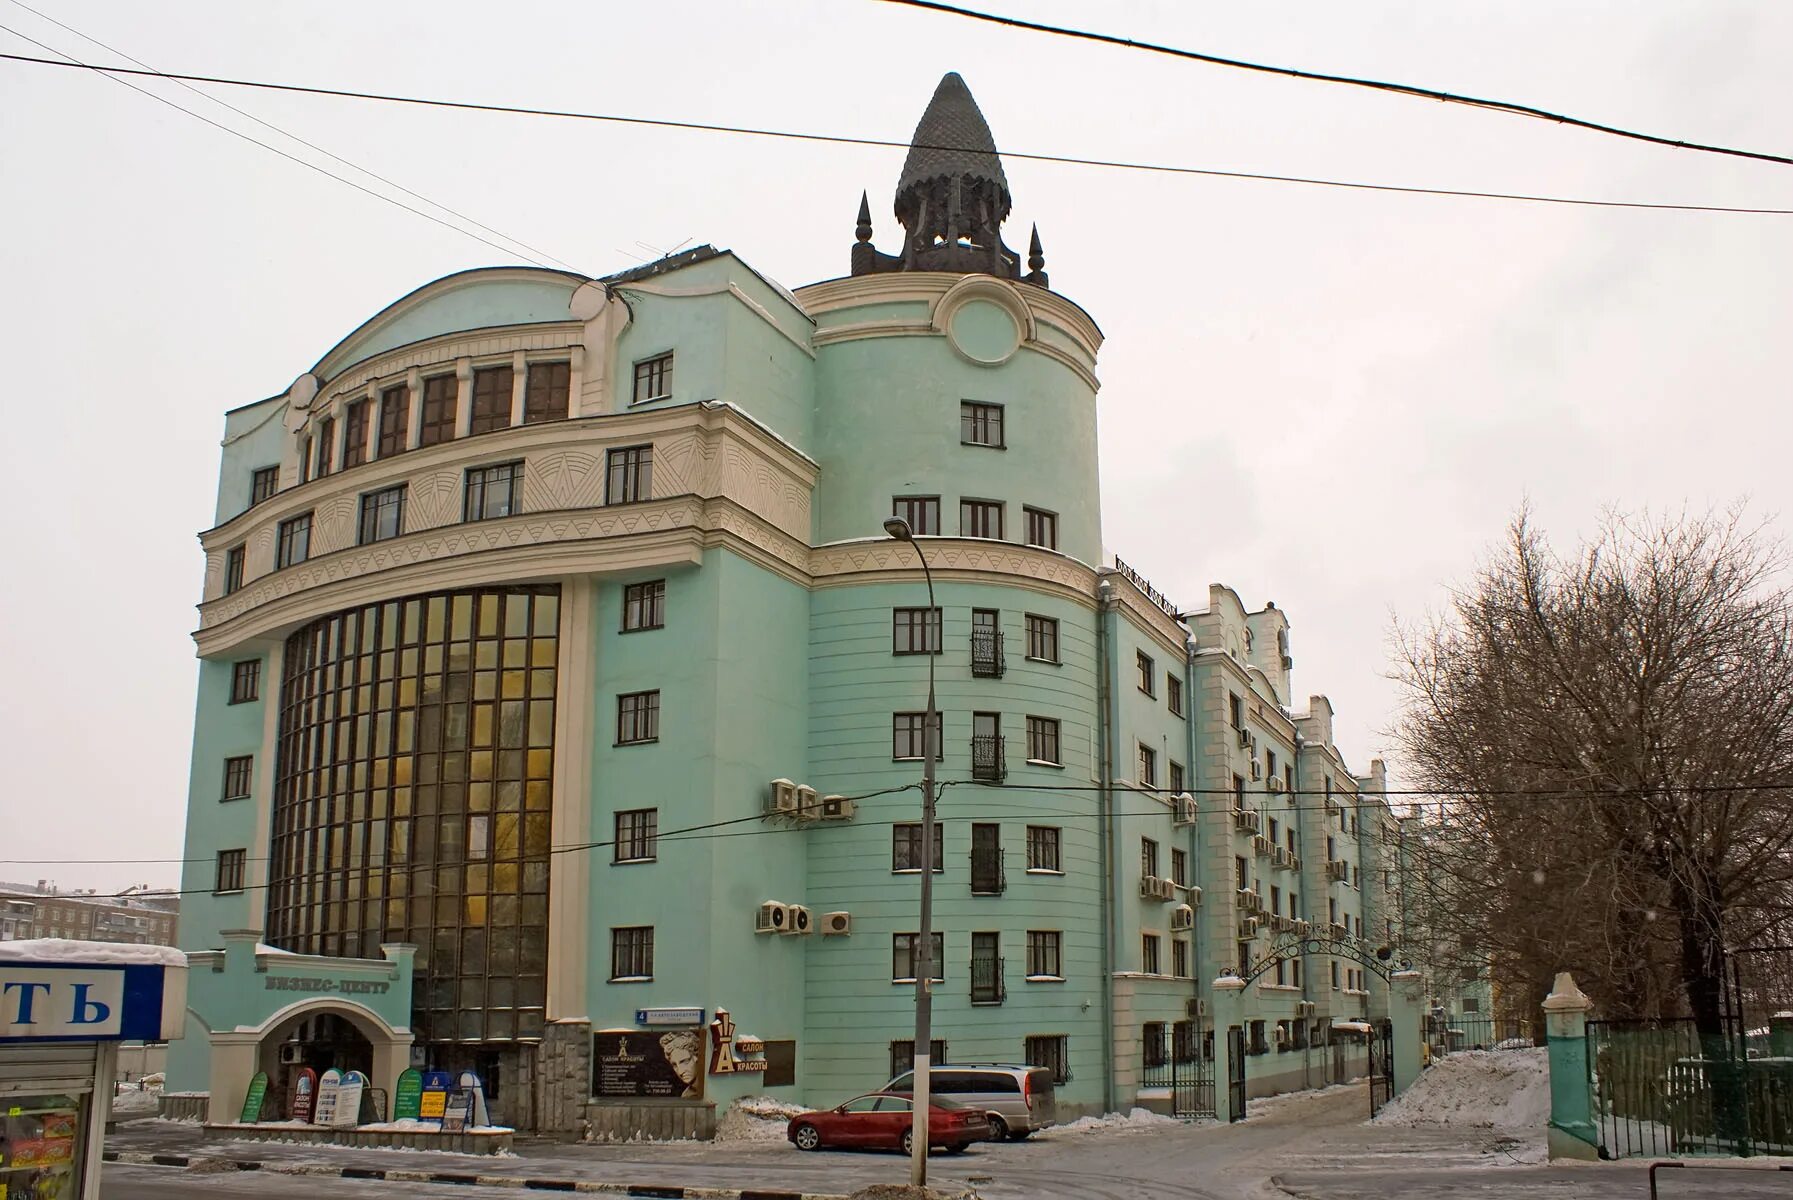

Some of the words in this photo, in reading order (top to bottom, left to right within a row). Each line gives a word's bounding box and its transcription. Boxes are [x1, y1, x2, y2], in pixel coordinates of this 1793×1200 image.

[265, 976, 390, 995] БИЗНЕС-ЦЕНТР
[3, 982, 111, 1025] ТЬ
[640, 1012, 644, 1020] 4
[742, 1043, 764, 1052] САЛОН
[737, 1062, 768, 1071] КРАСОТЫ
